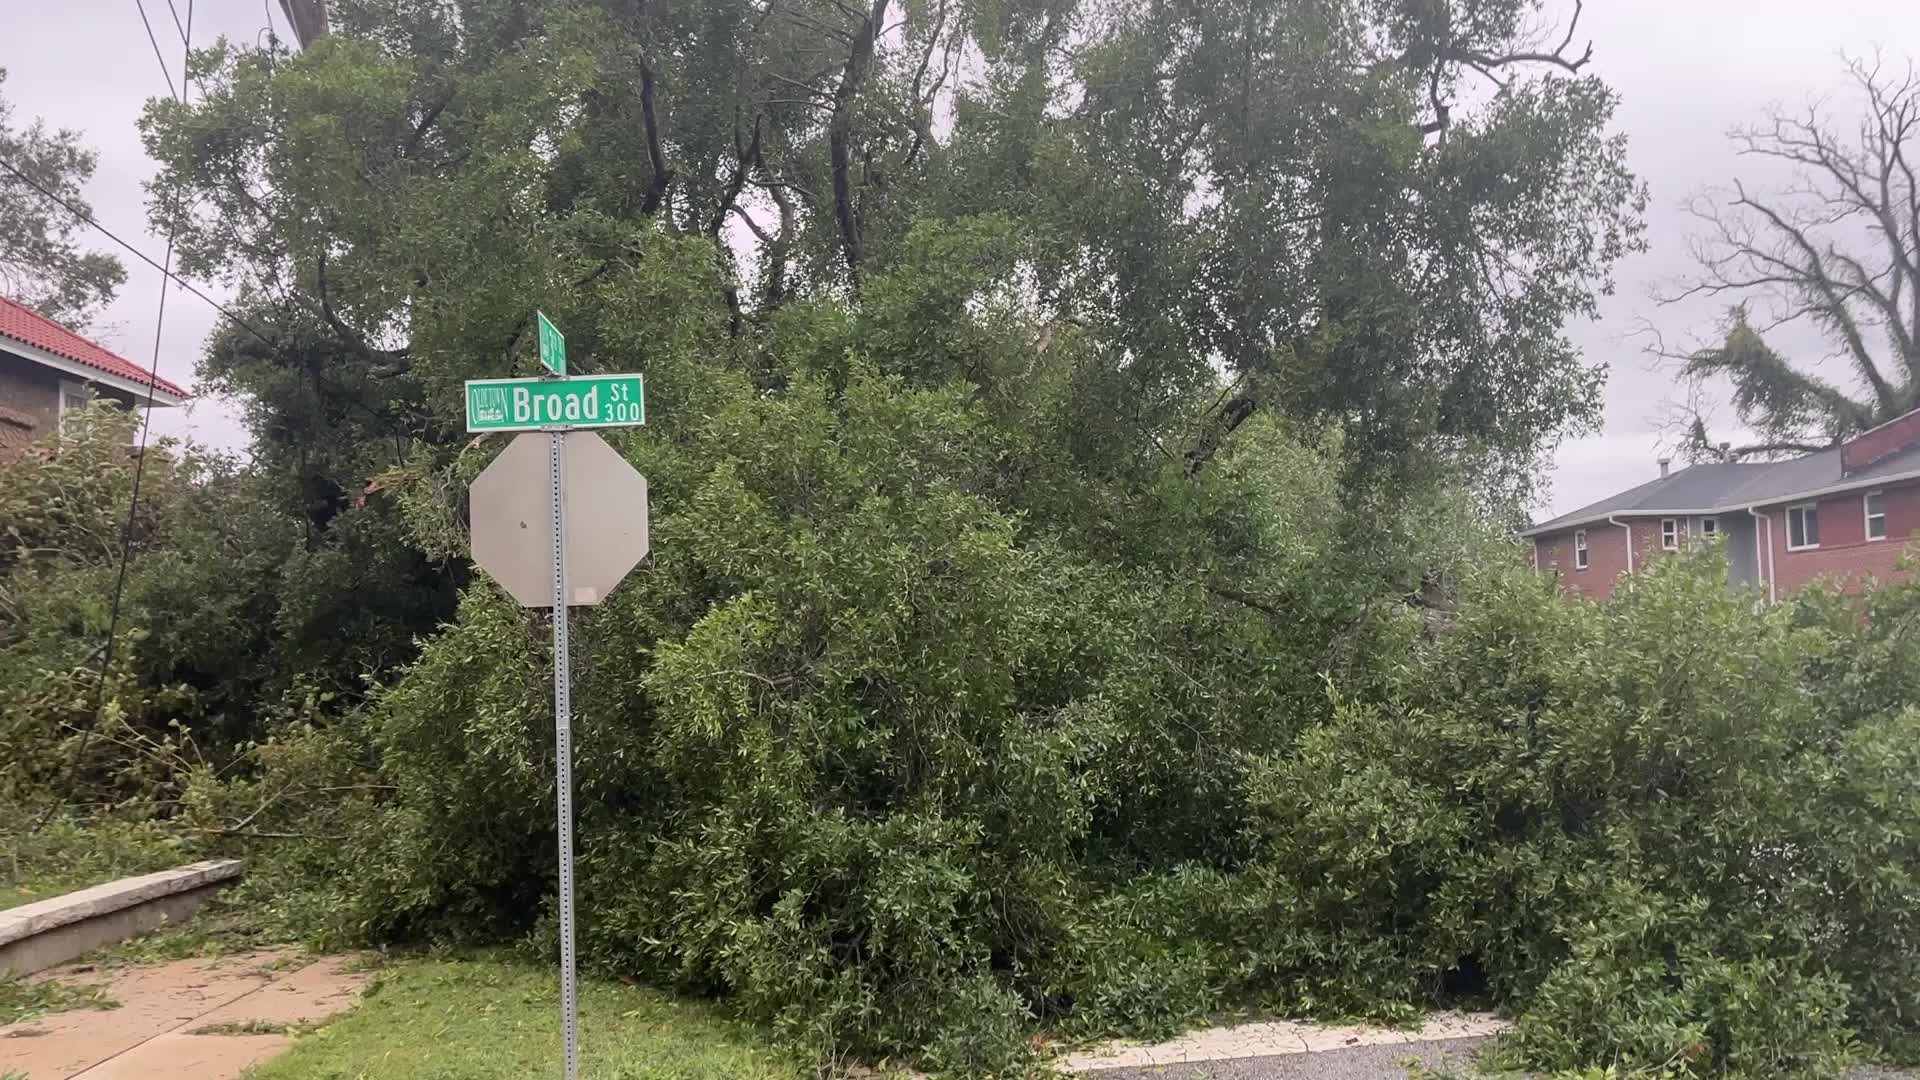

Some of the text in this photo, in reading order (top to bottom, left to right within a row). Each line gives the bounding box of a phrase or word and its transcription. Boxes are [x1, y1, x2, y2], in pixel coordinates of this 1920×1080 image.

[513, 385, 599, 422] Broad
[610, 383, 629, 402] St
[604, 403, 639, 422] 300
